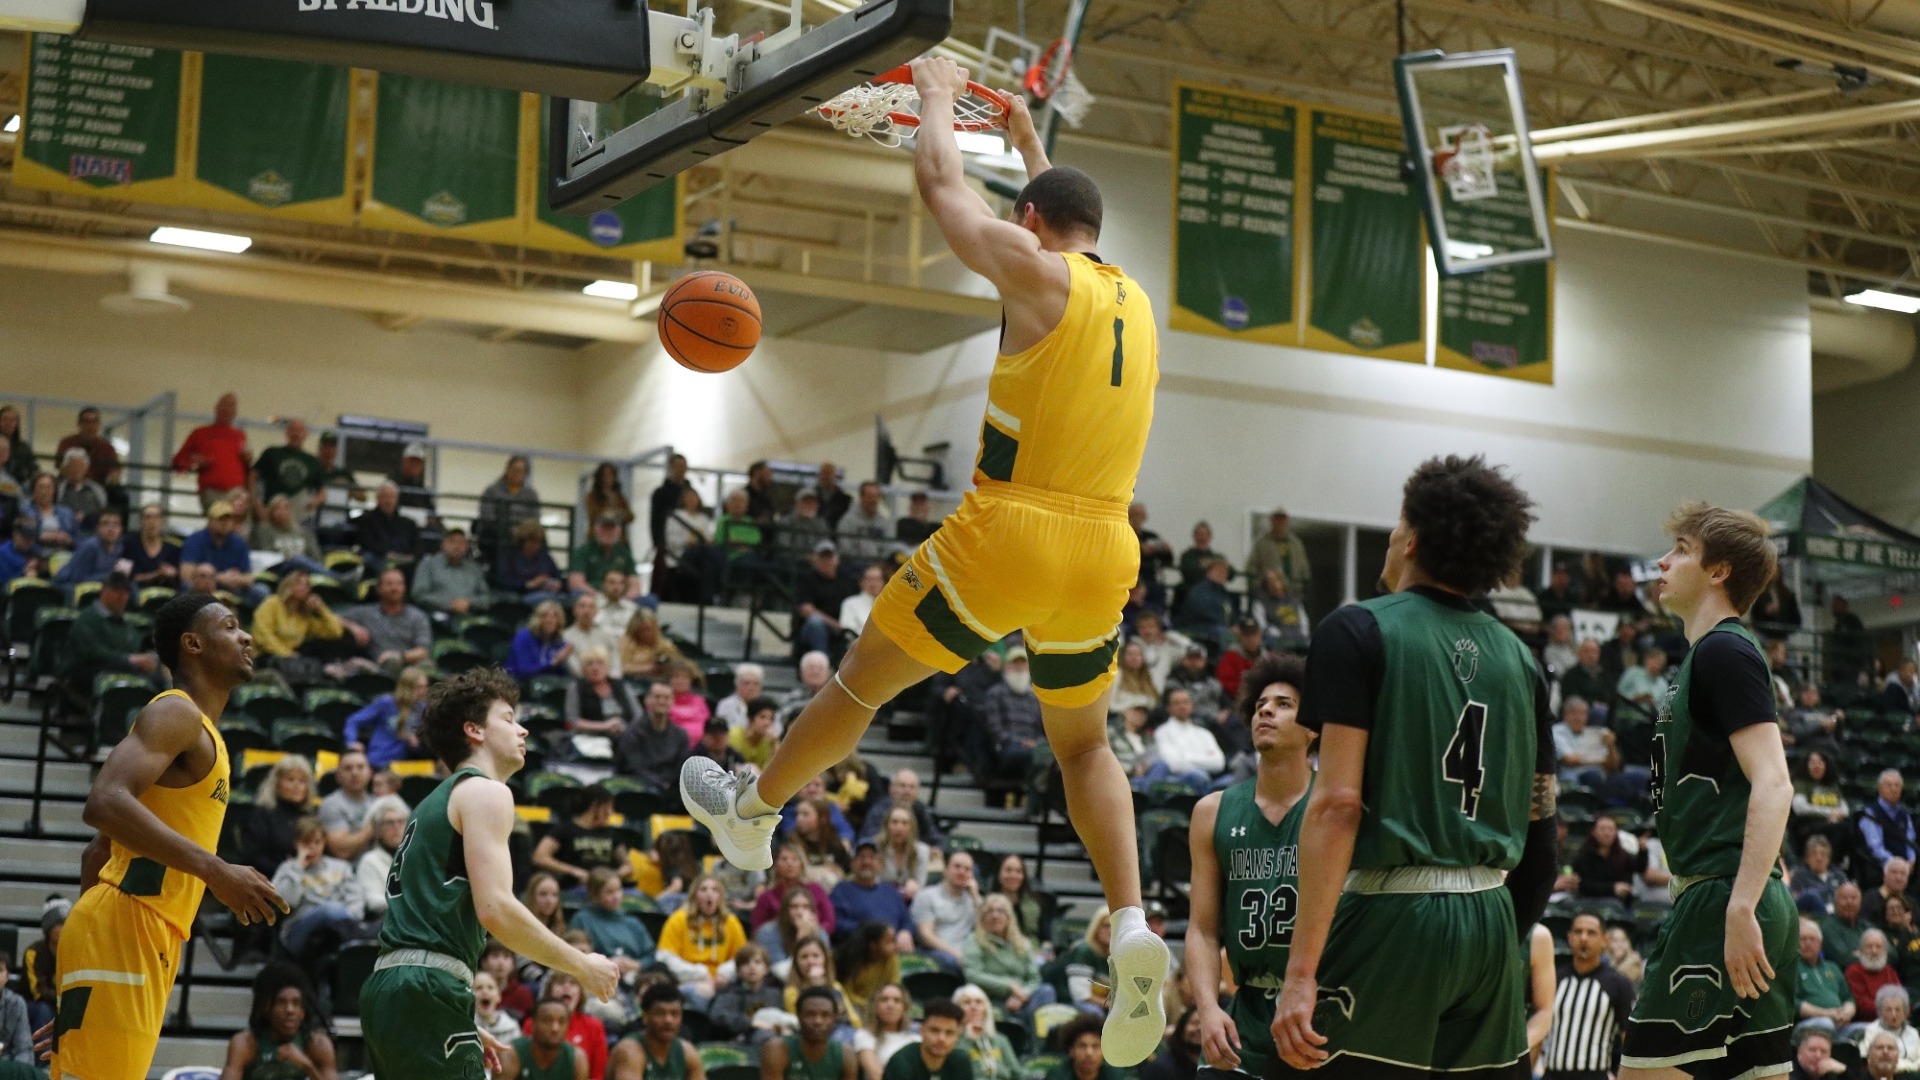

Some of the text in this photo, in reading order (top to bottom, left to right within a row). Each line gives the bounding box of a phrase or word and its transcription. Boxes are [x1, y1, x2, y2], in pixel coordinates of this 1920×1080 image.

[298, 0, 494, 30] SALDING
[1110, 316, 1124, 387] 1
[1442, 700, 1488, 821] 4
[1229, 845, 1299, 880] ADAMS STA
[1239, 884, 1299, 950] 32
